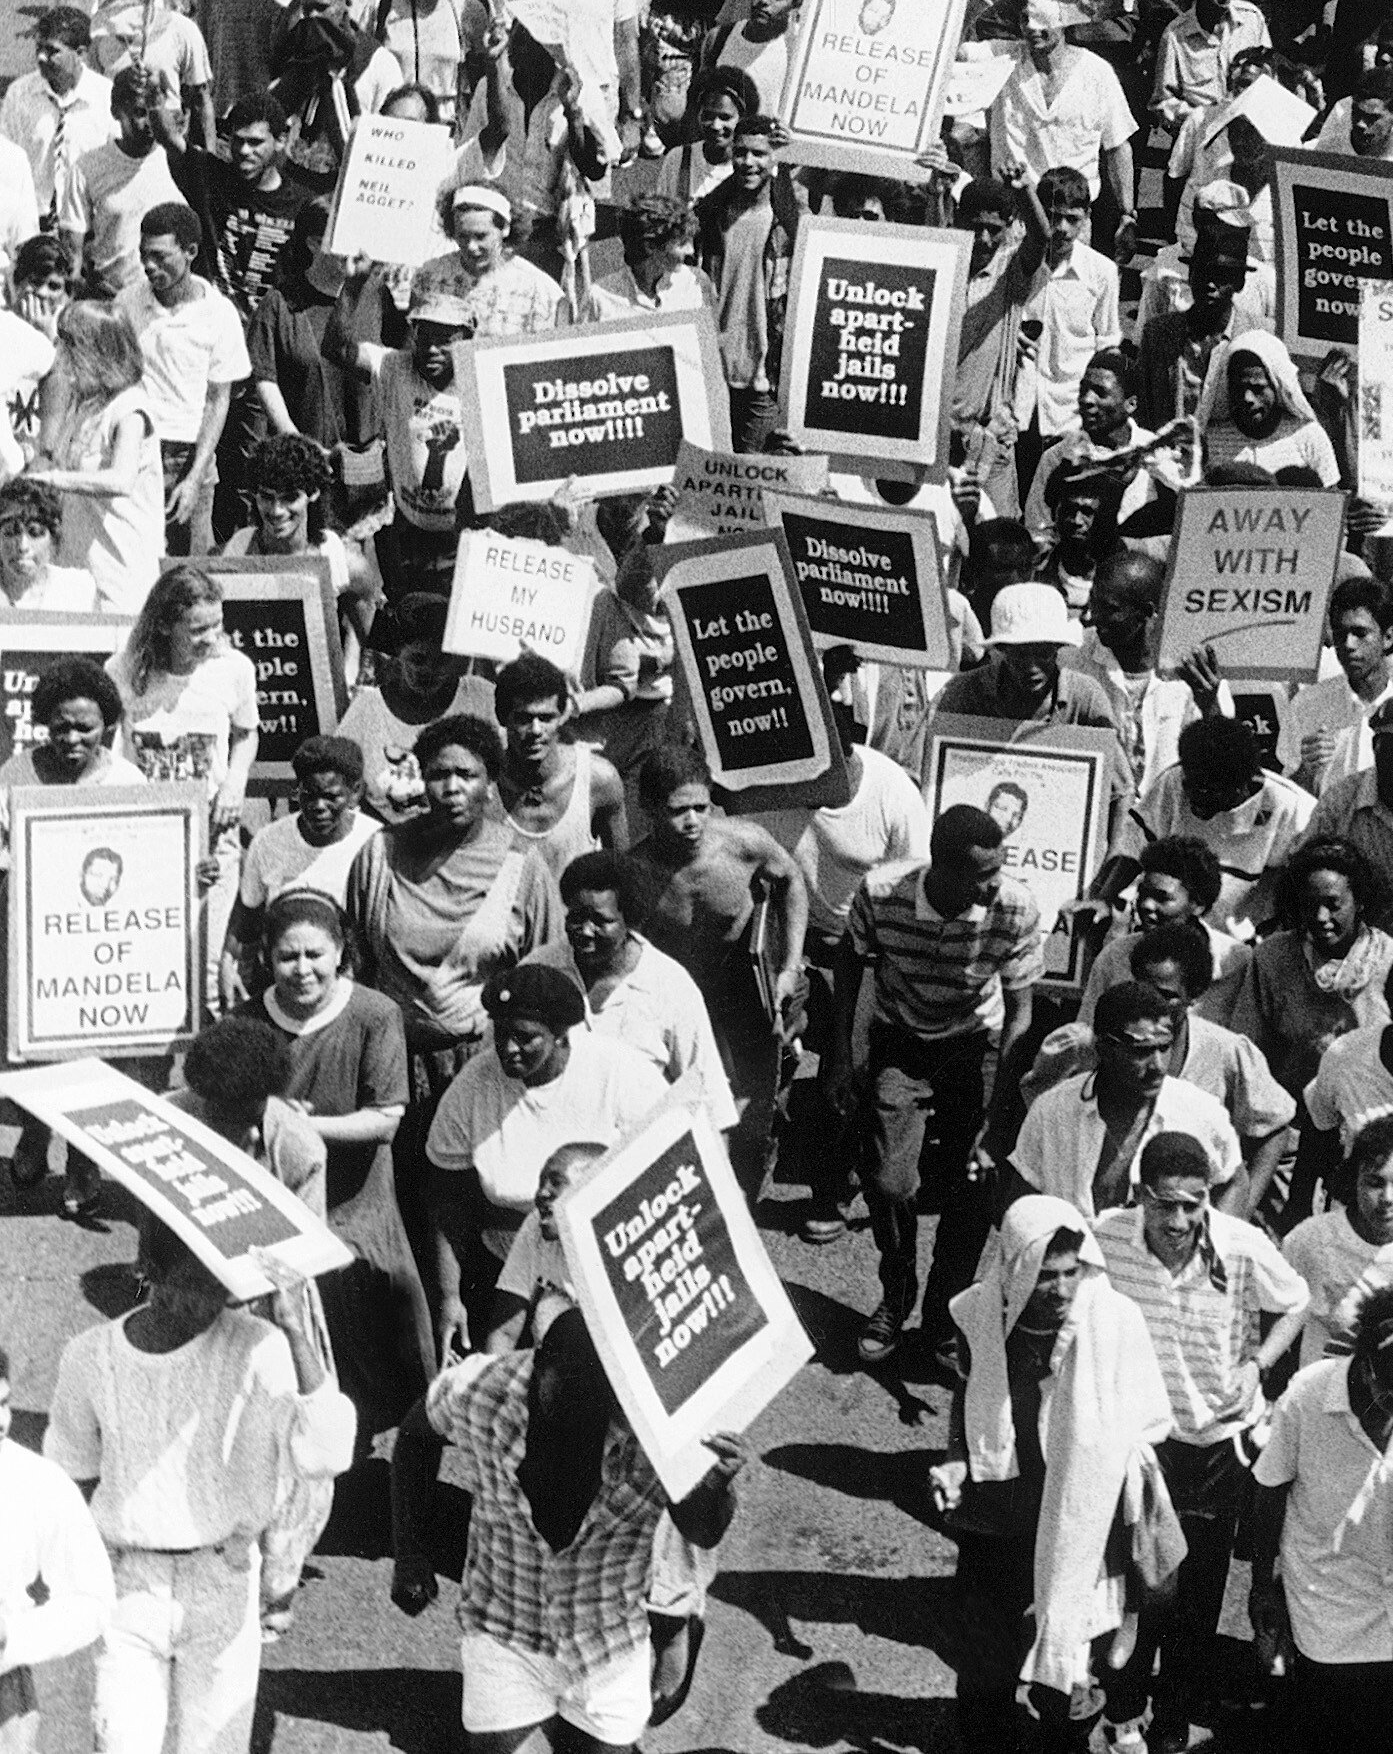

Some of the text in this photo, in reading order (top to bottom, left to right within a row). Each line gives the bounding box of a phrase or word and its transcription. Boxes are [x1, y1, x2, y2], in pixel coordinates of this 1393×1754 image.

[821, 32, 933, 68] RELEASE
[855, 64, 888, 85] OF
[803, 82, 919, 117] MANDELA
[371, 127, 405, 142] WHO
[830, 113, 889, 138] NOW
[364, 153, 416, 171] KILLED
[359, 179, 391, 195] NEIL
[1301, 210, 1384, 240] Let the
[1307, 241, 1383, 267] people
[1303, 267, 1362, 289] gove
[826, 277, 926, 312] Unlock
[829, 307, 915, 333] apart-
[838, 328, 901, 357] heid
[833, 352, 896, 381] jails
[531, 371, 650, 404] Dissolve
[820, 380, 908, 407] now!!!
[517, 390, 672, 434] parliament
[548, 415, 645, 448] now!!!!
[704, 460, 789, 483] UNLOCK
[1206, 507, 1313, 534] AWAY
[485, 546, 575, 583] RELEASE
[804, 535, 893, 572] Dissolve
[1213, 548, 1300, 575] WITH
[796, 559, 911, 596] parliament
[510, 584, 539, 607] MY
[819, 587, 890, 615] now!!!!
[1184, 588, 1313, 614] SEXISM
[253, 628, 299, 648] the
[470, 610, 566, 646] HUSBAND
[691, 609, 774, 641] Let the
[257, 656, 299, 682] ple
[705, 641, 779, 678] people
[259, 714, 298, 734] w!!
[726, 706, 789, 737] now!!
[1002, 845, 1078, 874] EASE
[43, 907, 182, 937] RELEASE
[93, 940, 134, 966] OF
[36, 970, 182, 1000] MANDELA
[79, 1002, 149, 1029] NOW
[83, 1112, 172, 1146] Unlock
[603, 1164, 702, 1259] Unlock
[622, 1202, 703, 1282] apart-
[639, 1227, 704, 1303] heid
[653, 1263, 712, 1337] jails
[653, 1273, 737, 1369] now!!!
